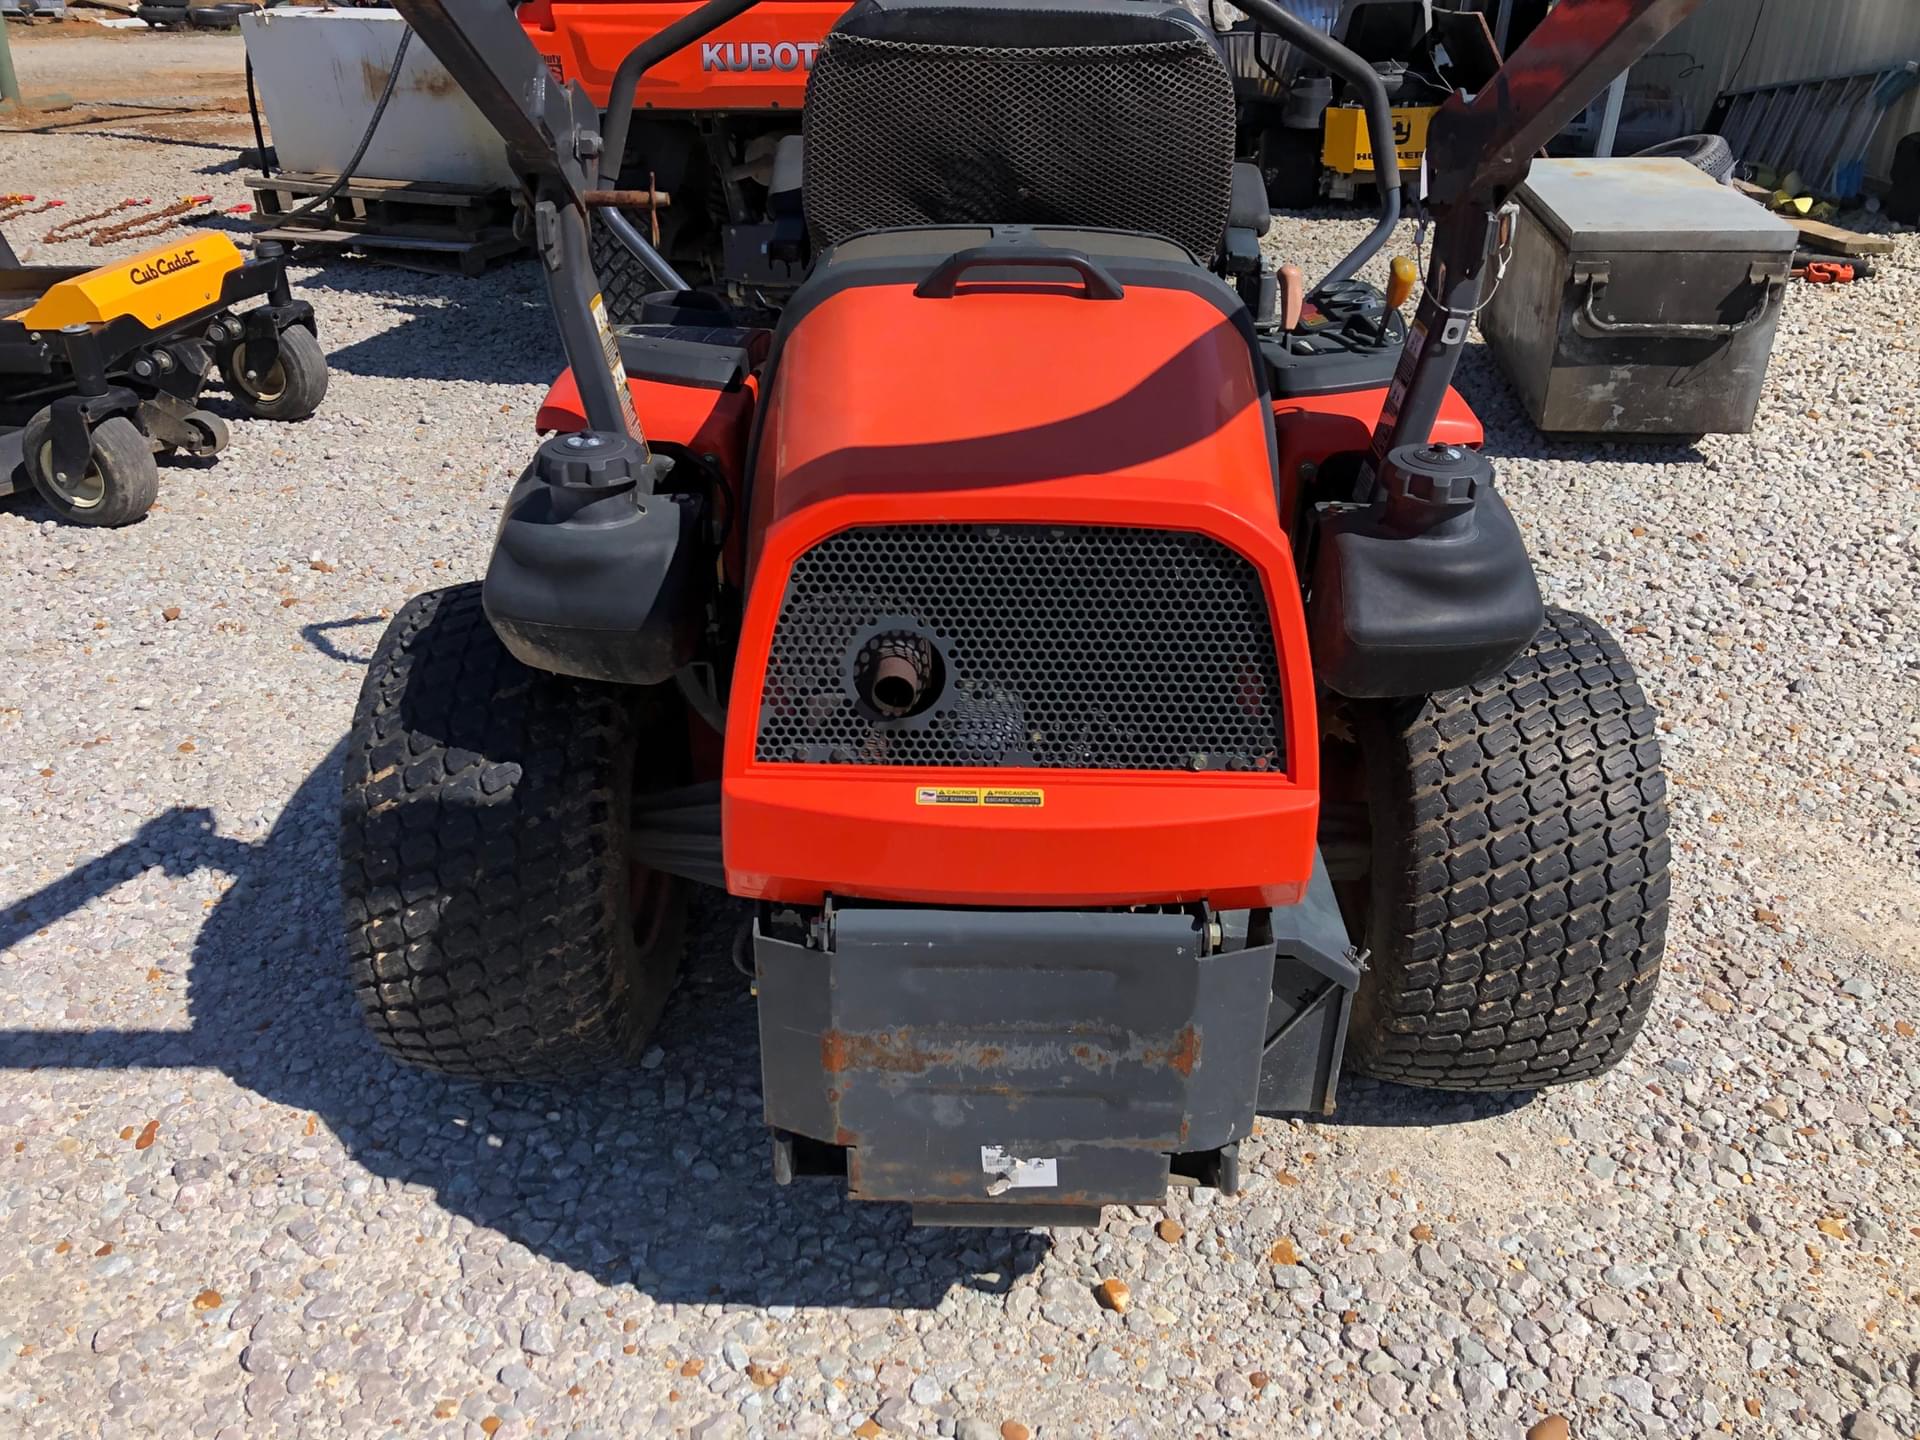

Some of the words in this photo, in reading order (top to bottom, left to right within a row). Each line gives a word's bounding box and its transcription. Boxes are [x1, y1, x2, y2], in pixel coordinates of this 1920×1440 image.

[702, 42, 820, 72] KUBOT
[130, 263, 159, 285] Cub
[156, 250, 200, 275] Cadet
